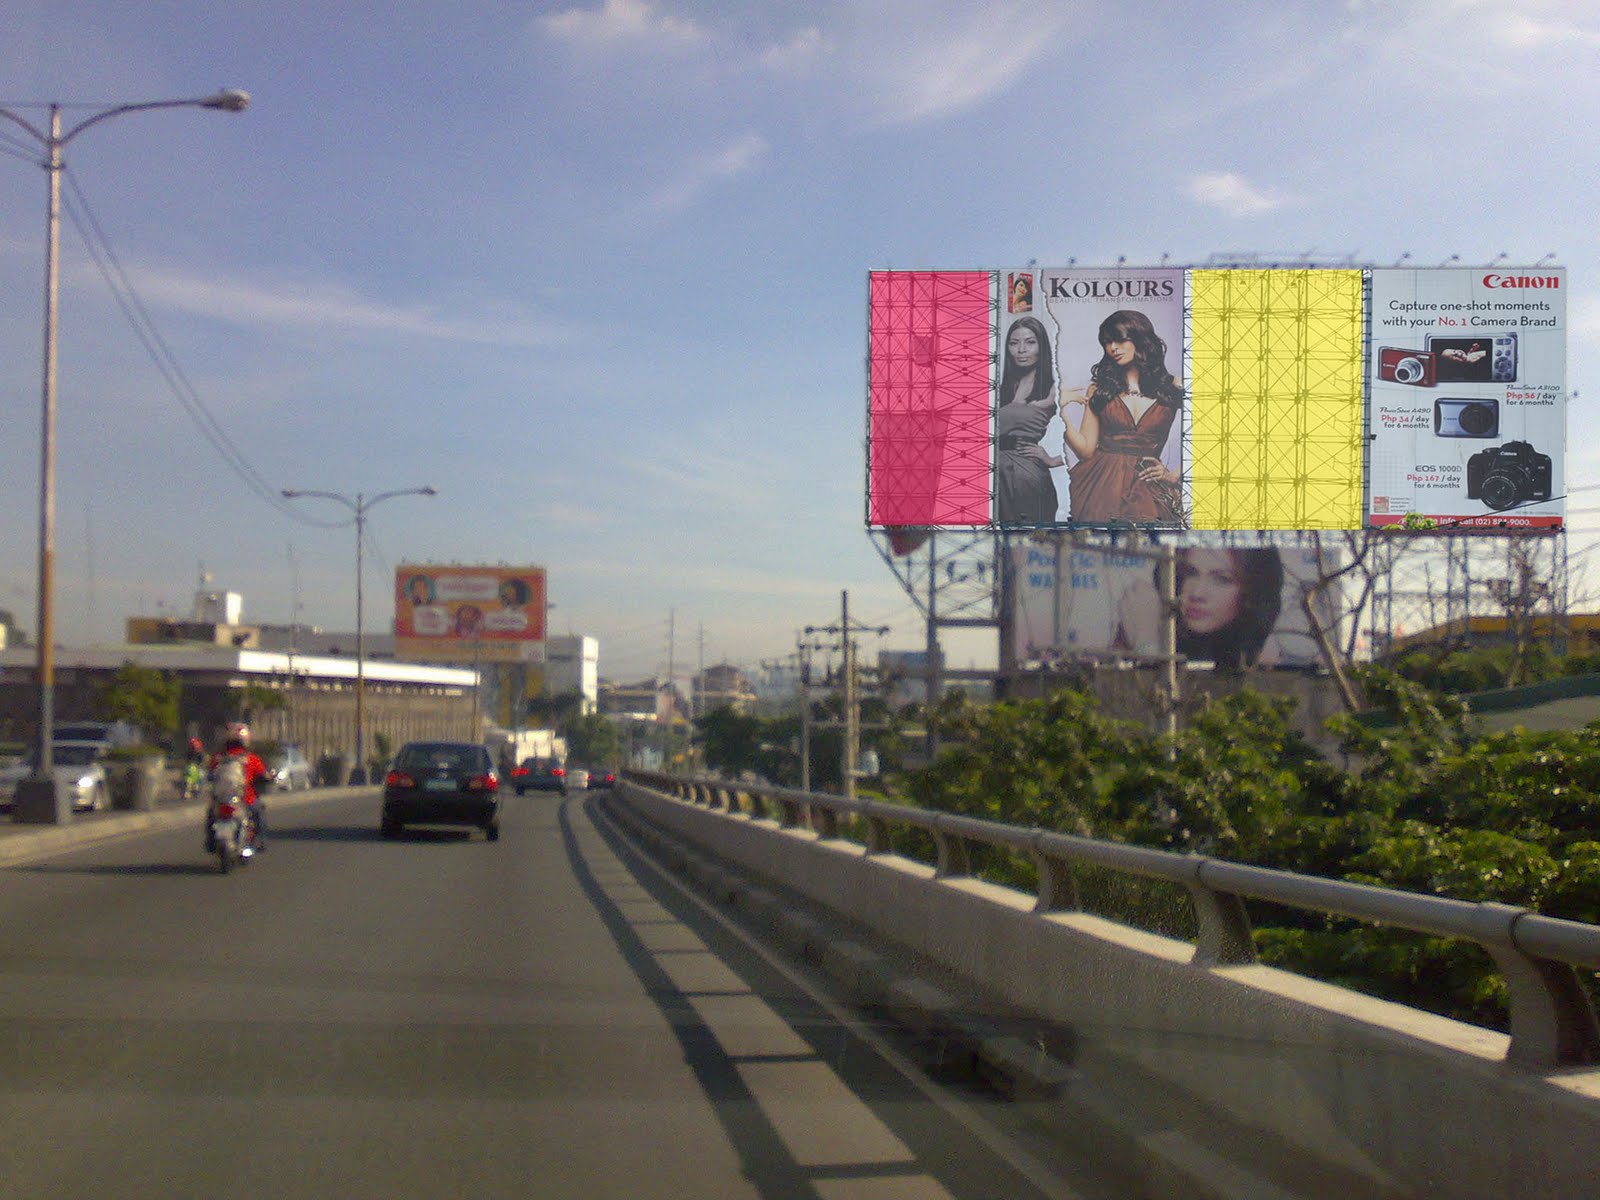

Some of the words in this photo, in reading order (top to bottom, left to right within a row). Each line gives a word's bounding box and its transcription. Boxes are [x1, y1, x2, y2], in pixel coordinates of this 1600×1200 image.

[1482, 274, 1559, 289] Canon
[1049, 277, 1174, 298] KOLOURS
[1389, 300, 1438, 313] Capture
[1440, 299, 1492, 311] one-shot
[1494, 301, 1550, 311] moments
[1382, 315, 1407, 326] with
[1409, 319, 1436, 329] your
[1438, 316, 1459, 326] No.
[1461, 318, 1467, 326] 1
[1470, 315, 1518, 326] Camera
[1520, 315, 1556, 326] Brand
[1506, 392, 1523, 400] Php
[1542, 392, 1556, 401] day
[1381, 414, 1398, 423] Php
[1416, 415, 1430, 423] day
[1415, 464, 1437, 472] EOS
[1439, 465, 1462, 473] 1000D
[1406, 474, 1423, 483] Php
[1446, 475, 1461, 483] day
[1475, 517, 1491, 526] (02)
